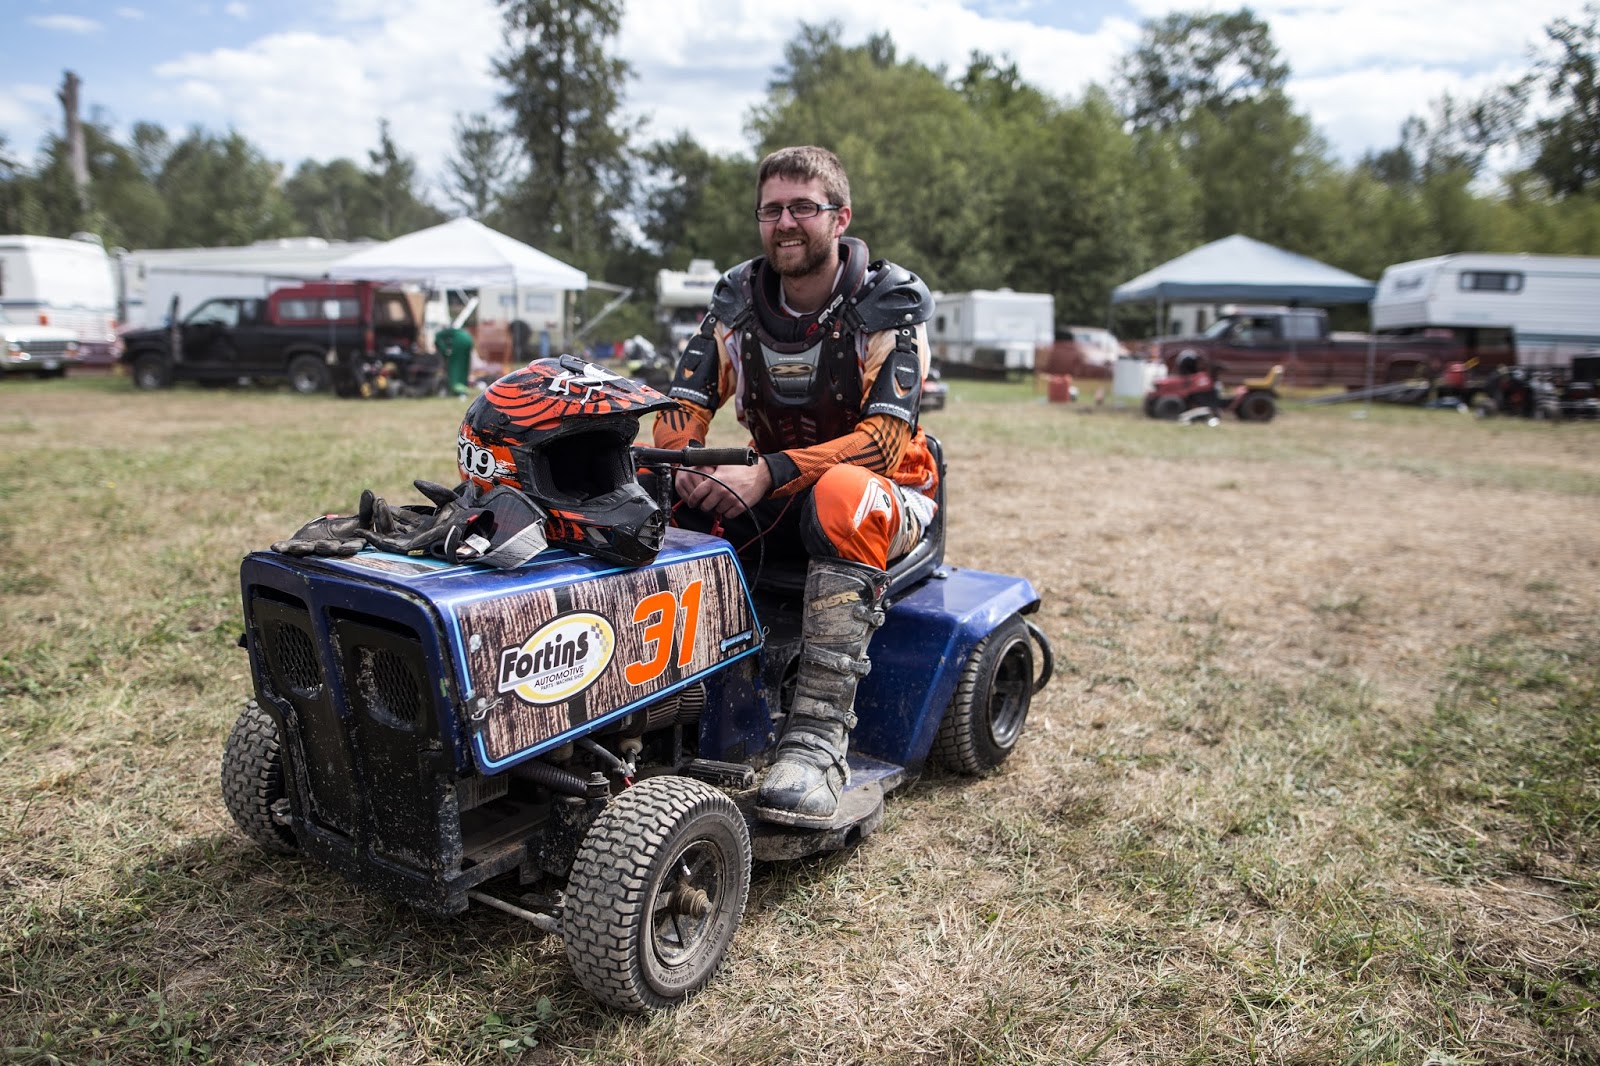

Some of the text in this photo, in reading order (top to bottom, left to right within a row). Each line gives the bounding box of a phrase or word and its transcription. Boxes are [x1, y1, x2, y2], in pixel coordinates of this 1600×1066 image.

[818, 294, 844, 324] EVS
[625, 579, 703, 686] 31
[501, 630, 589, 684] Fortins
[534, 664, 584, 688] AUTOMOTIVE
[540, 672, 584, 691] PARTS MACHINE SHOP
